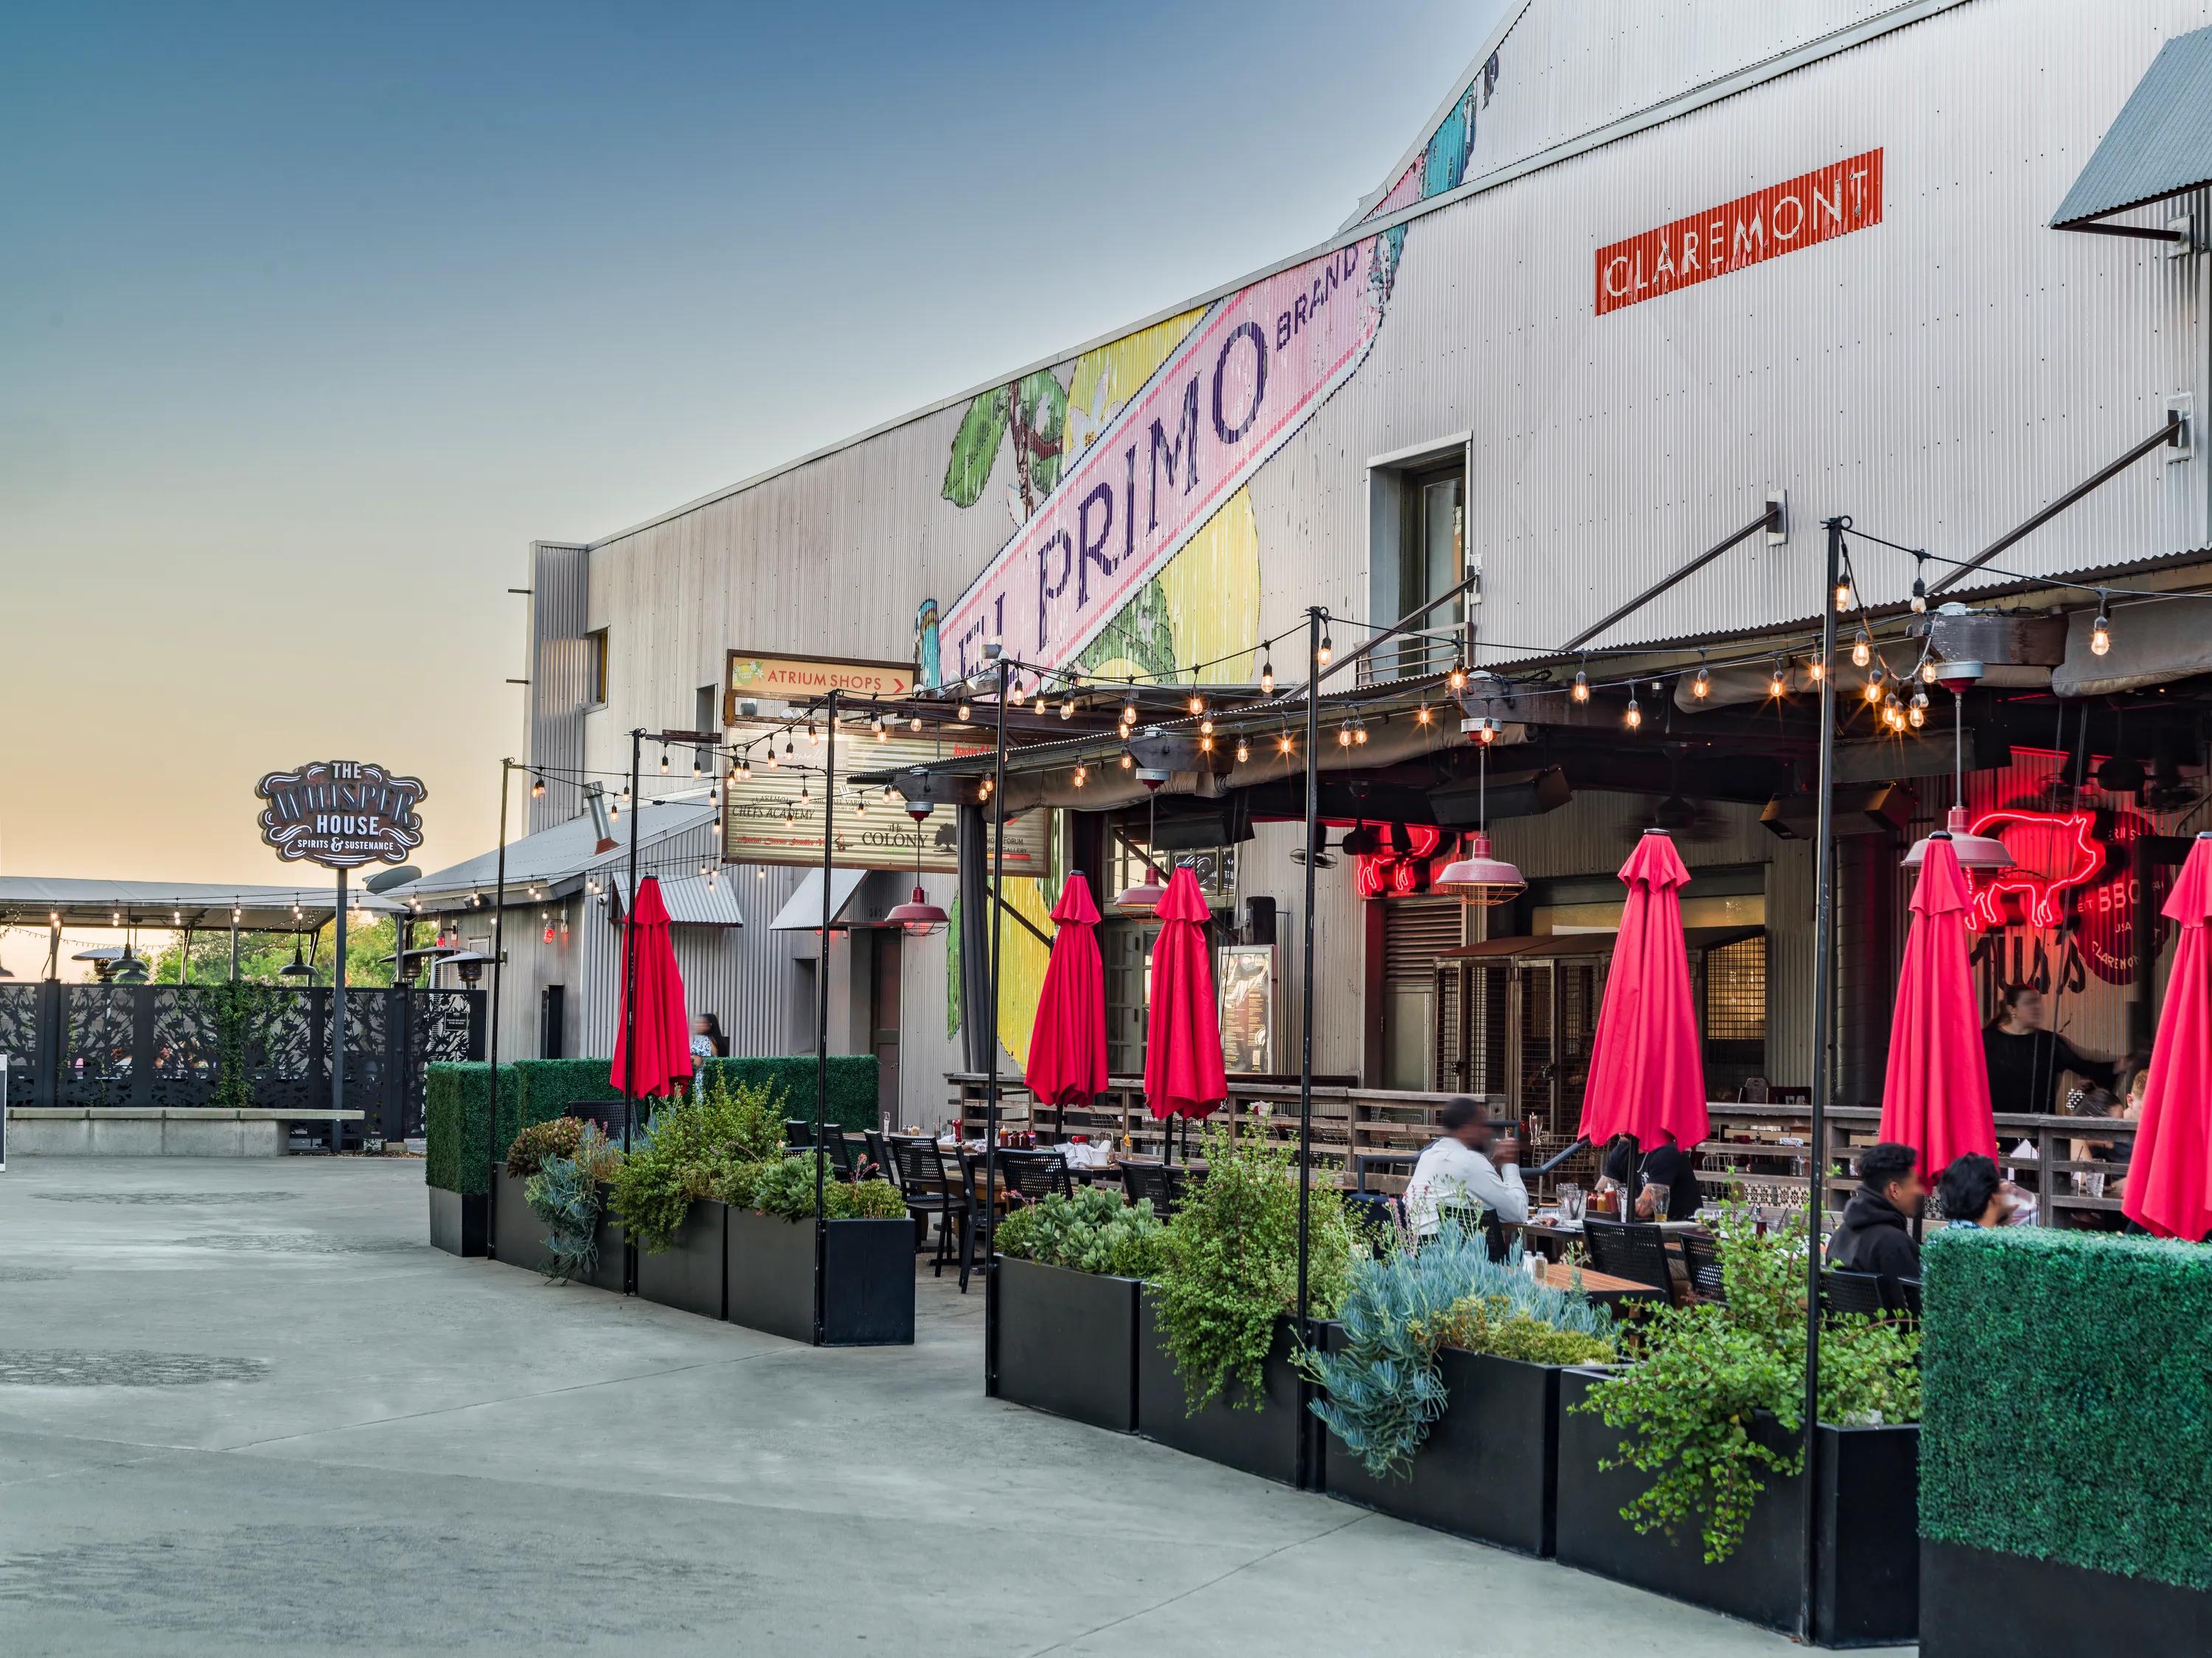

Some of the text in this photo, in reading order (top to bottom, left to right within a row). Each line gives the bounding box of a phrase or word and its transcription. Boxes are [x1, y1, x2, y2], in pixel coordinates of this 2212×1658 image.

[1606, 169, 1868, 297] CLAREMONT
[1276, 241, 1358, 352] BRAND
[1037, 320, 1268, 652] PRIMO
[768, 669, 827, 686] ATRIUM
[830, 674, 882, 691] SHOPS
[333, 762, 362, 779] THE
[271, 784, 414, 827] WHISPER
[732, 804, 764, 818] CHEFS
[766, 807, 815, 821] ACADEMY
[316, 815, 380, 835] HOUSE
[888, 823, 904, 832] THE
[297, 837, 394, 852] SPIRITS & SUSTENANCE
[861, 831, 929, 849] COLONY
[1003, 836, 1023, 845] FORUM
